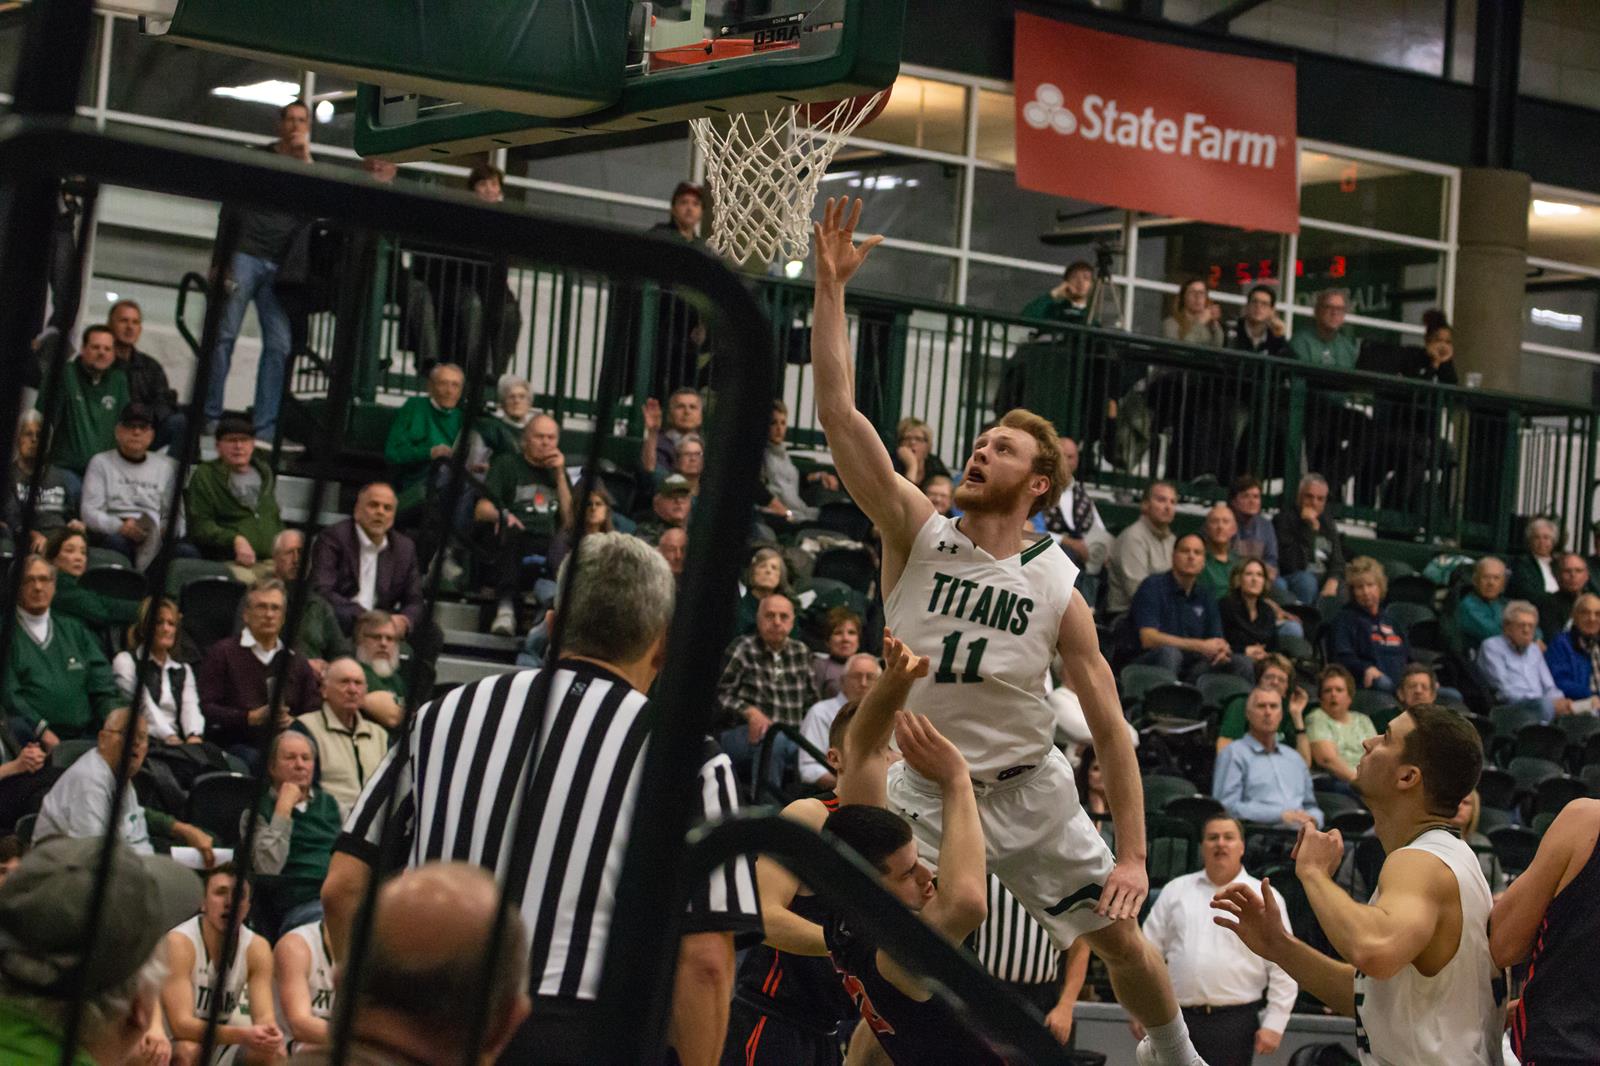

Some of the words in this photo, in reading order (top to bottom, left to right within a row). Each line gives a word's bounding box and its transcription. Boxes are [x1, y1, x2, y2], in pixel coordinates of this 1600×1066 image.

[1080, 94, 1277, 168] StateFarm
[927, 571, 1034, 636] TITANS
[934, 630, 989, 684] 11
